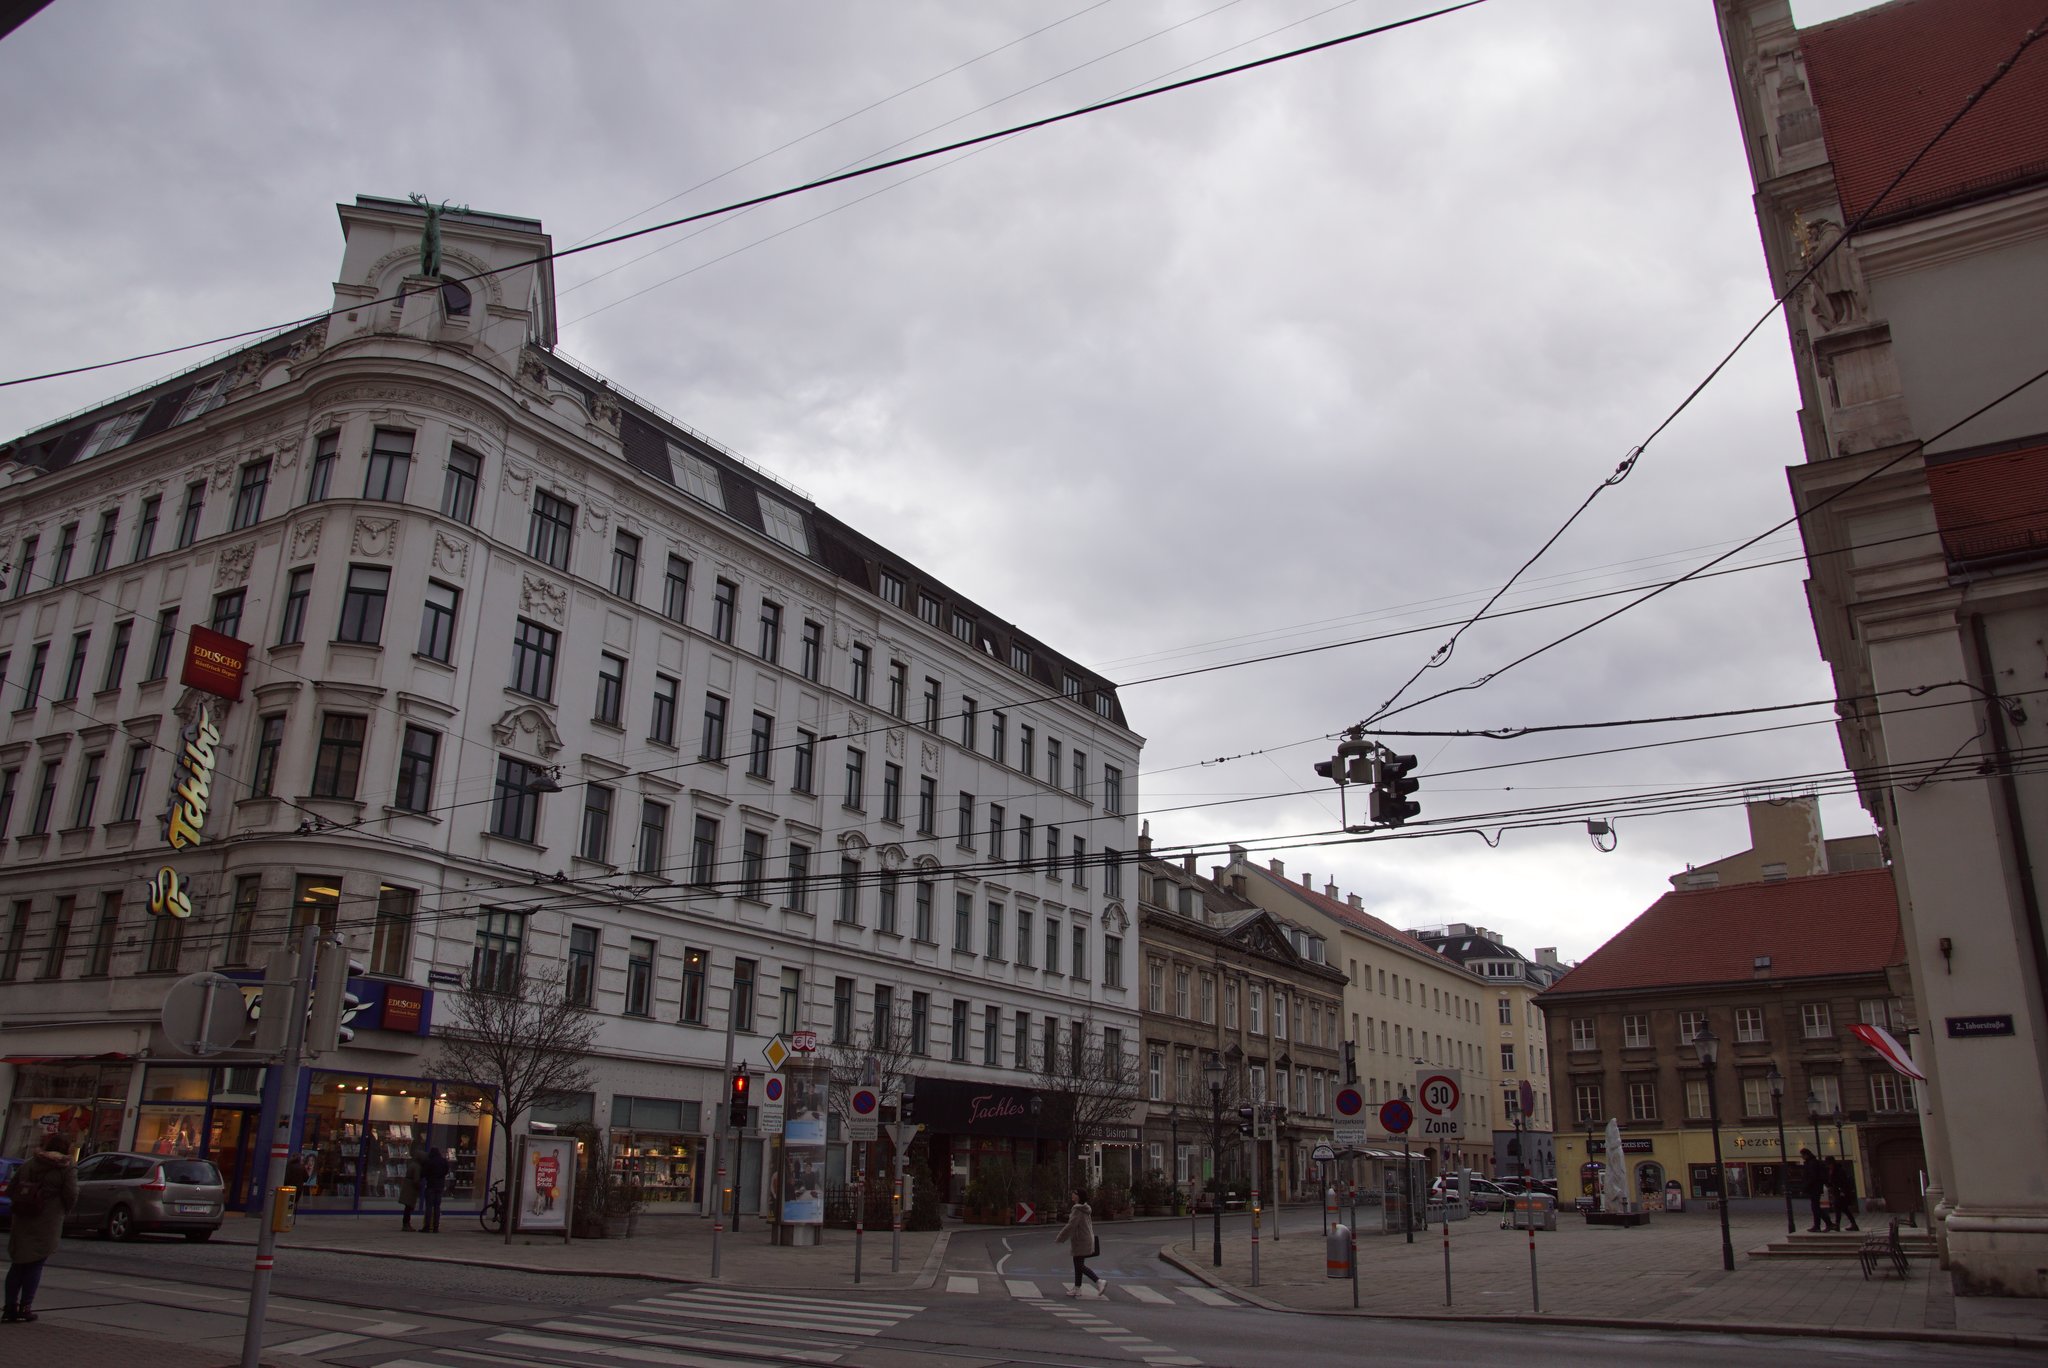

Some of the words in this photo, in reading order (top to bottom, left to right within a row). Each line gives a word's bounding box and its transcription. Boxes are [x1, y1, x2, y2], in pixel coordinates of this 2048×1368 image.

[194, 645, 242, 670] EDUSCHO
[168, 702, 220, 849] Tchibo
[388, 998, 421, 1011] EDUSCHO
[1430, 1086, 1449, 1105] 30
[968, 1094, 1025, 1124] Tachles
[1425, 1118, 1457, 1134] Zone
[1388, 1135, 1407, 1143] Anfang
